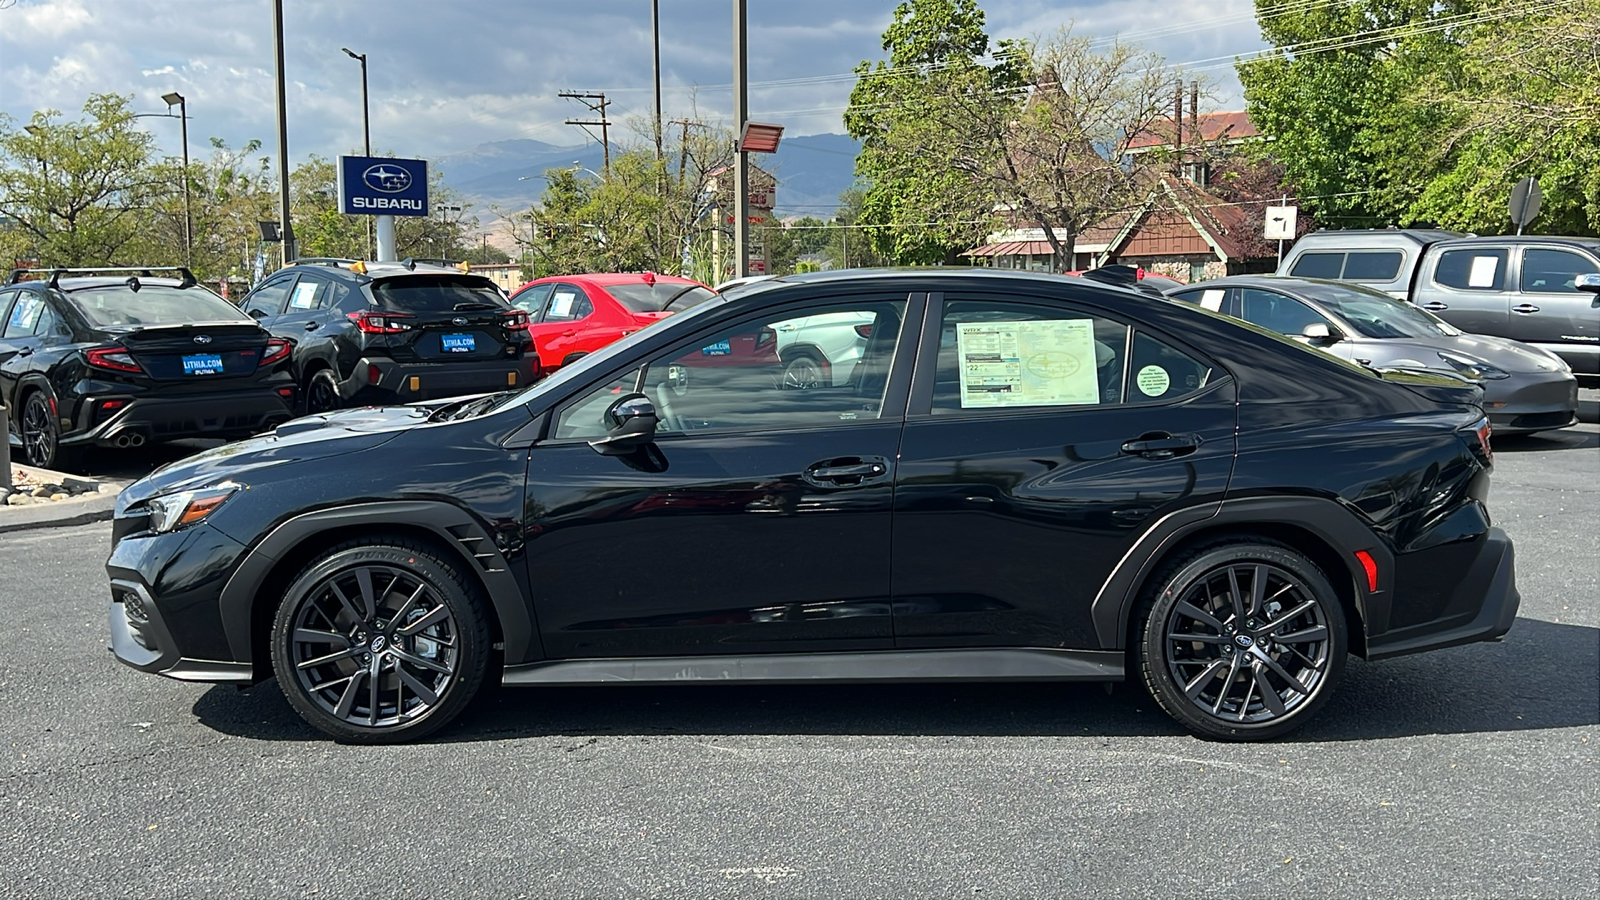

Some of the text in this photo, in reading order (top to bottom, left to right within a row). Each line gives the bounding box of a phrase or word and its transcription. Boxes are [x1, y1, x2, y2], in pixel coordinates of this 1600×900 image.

[352, 197, 422, 210] SUBARU
[443, 338, 475, 347] LITHIA.COM
[183, 359, 223, 369] LITHIA.COM
